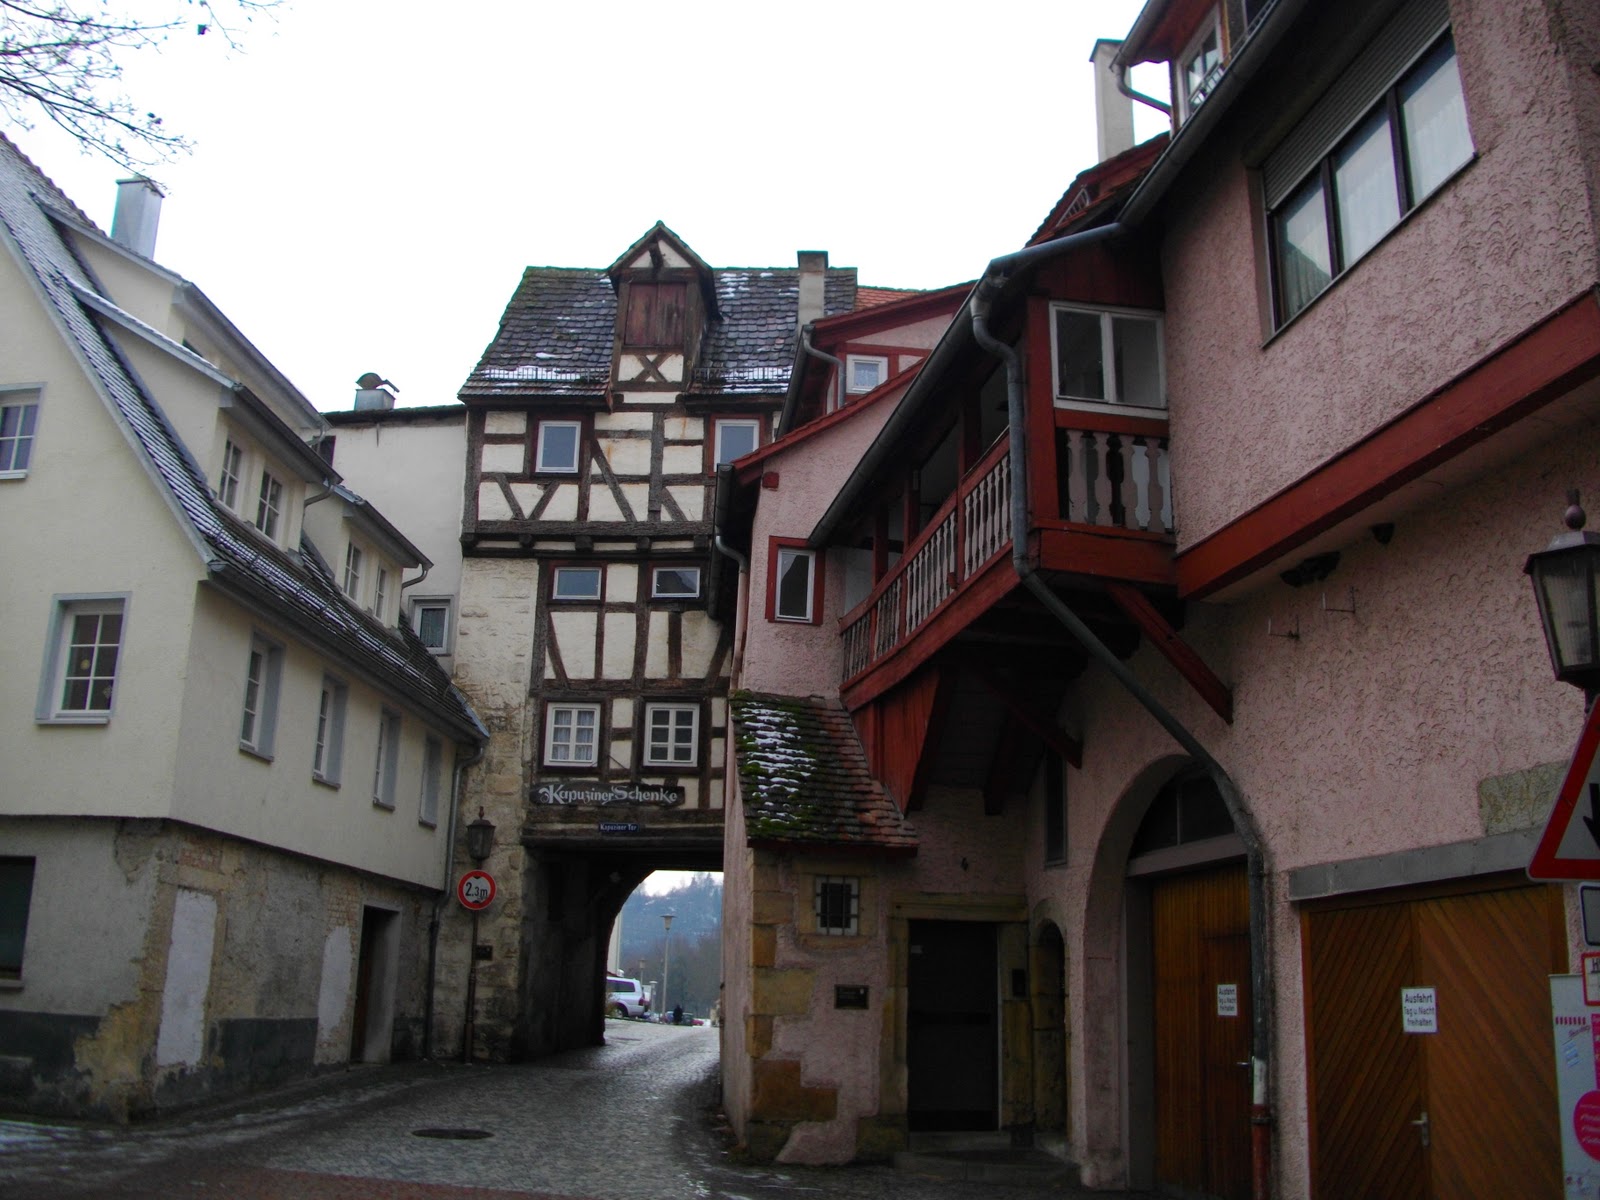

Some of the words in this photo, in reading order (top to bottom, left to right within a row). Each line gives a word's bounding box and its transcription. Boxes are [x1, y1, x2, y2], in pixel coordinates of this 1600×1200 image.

[539, 784, 614, 805] Kapuziner
[611, 785, 677, 804] Schenke
[1405, 993, 1432, 1003] Ausfahrt
